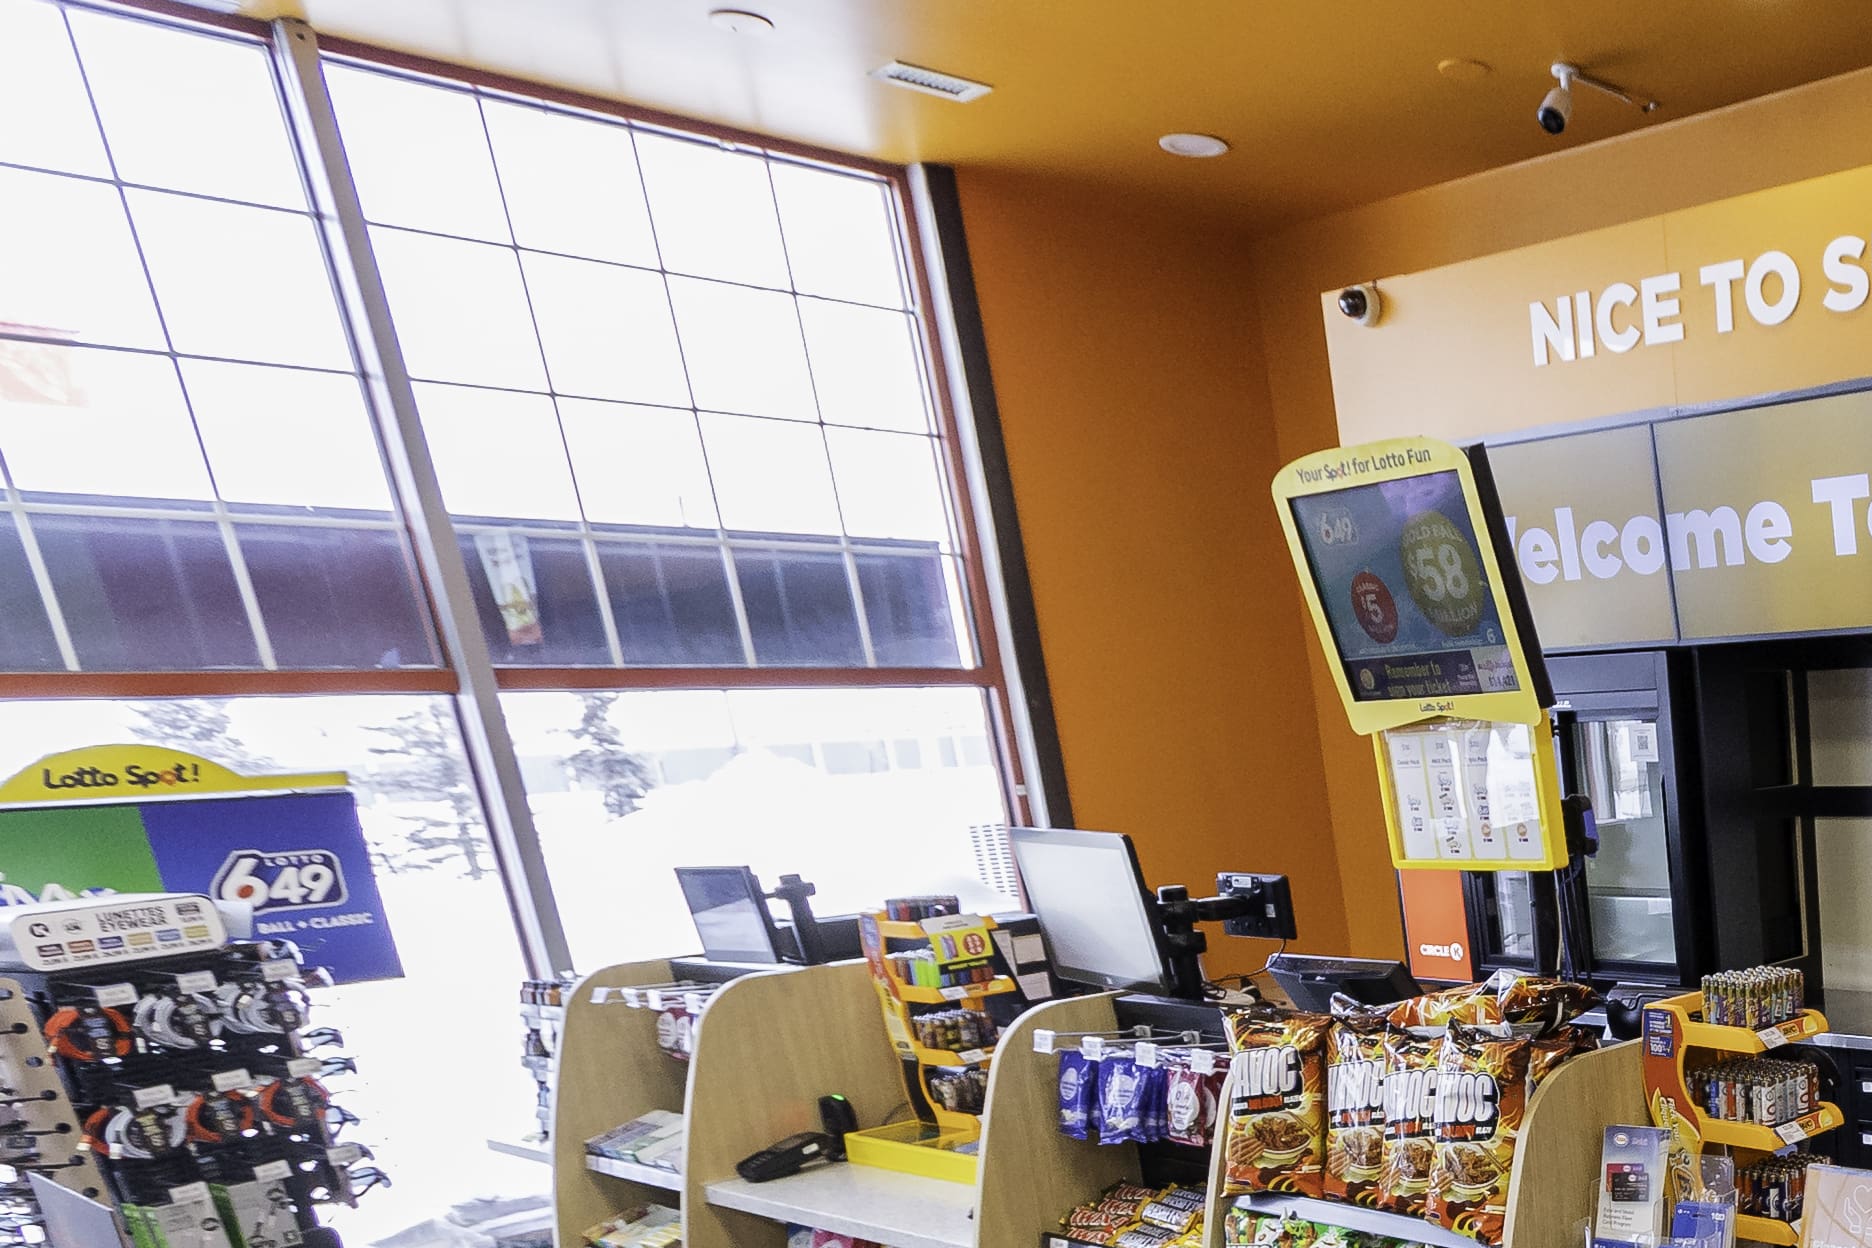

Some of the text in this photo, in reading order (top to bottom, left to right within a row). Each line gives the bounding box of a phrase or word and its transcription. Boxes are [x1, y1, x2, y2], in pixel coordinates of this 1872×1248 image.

[1529, 271, 1685, 367] NICE
[1700, 250, 1801, 333] TO
[1296, 466, 1323, 484] Your
[1352, 459, 1370, 473] for
[1373, 454, 1405, 471] Lotto
[1408, 448, 1431, 465] Fun
[1506, 500, 1793, 585] elcome
[43, 763, 199, 789] Lotto Spot!
[221, 857, 334, 907] 649
